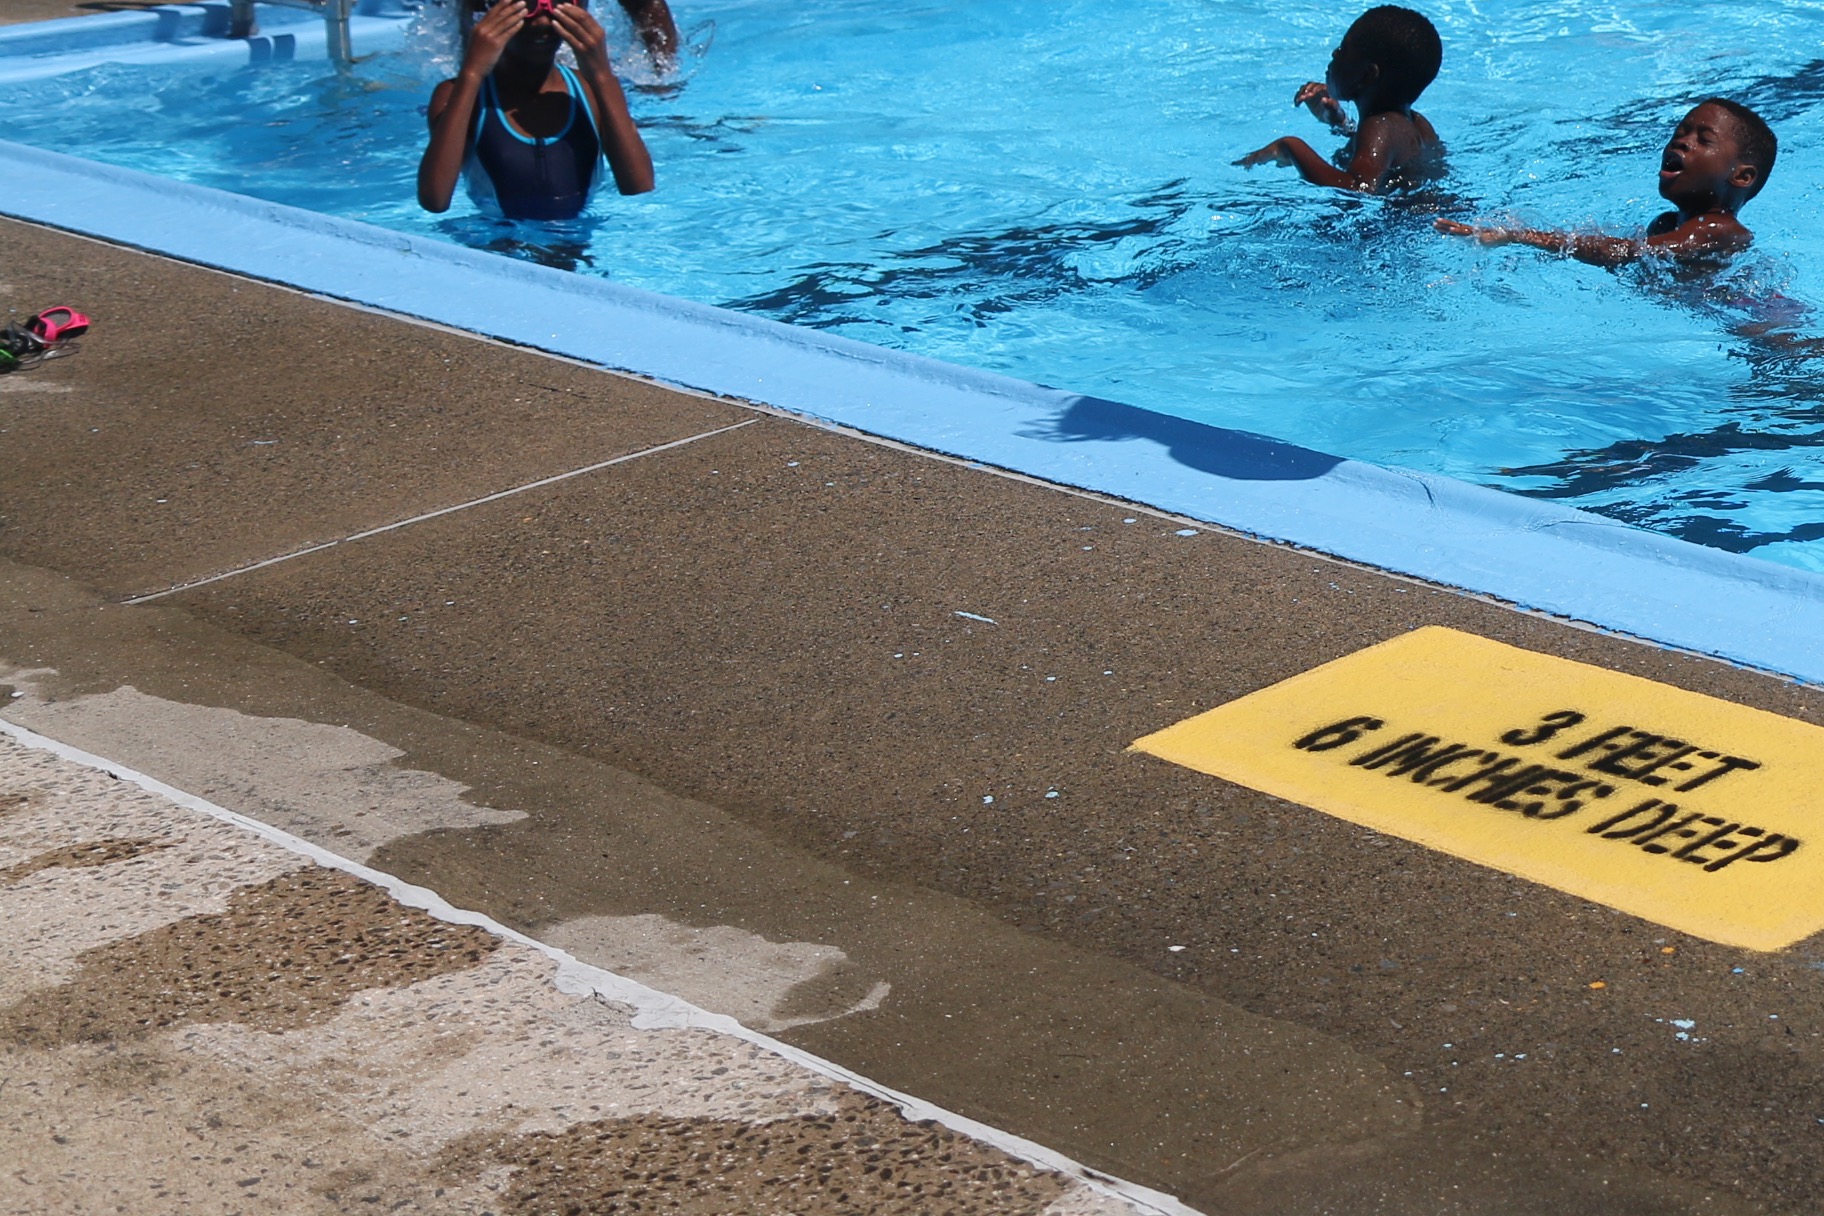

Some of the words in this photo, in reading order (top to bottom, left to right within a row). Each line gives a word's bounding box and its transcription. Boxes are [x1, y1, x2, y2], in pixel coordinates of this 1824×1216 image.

[1292, 715, 1383, 752] 6
[1350, 733, 1612, 820] INCHES
[1586, 798, 1801, 873] DEEP
[1502, 709, 1585, 747] 3
[1560, 725, 1761, 793] FEET
